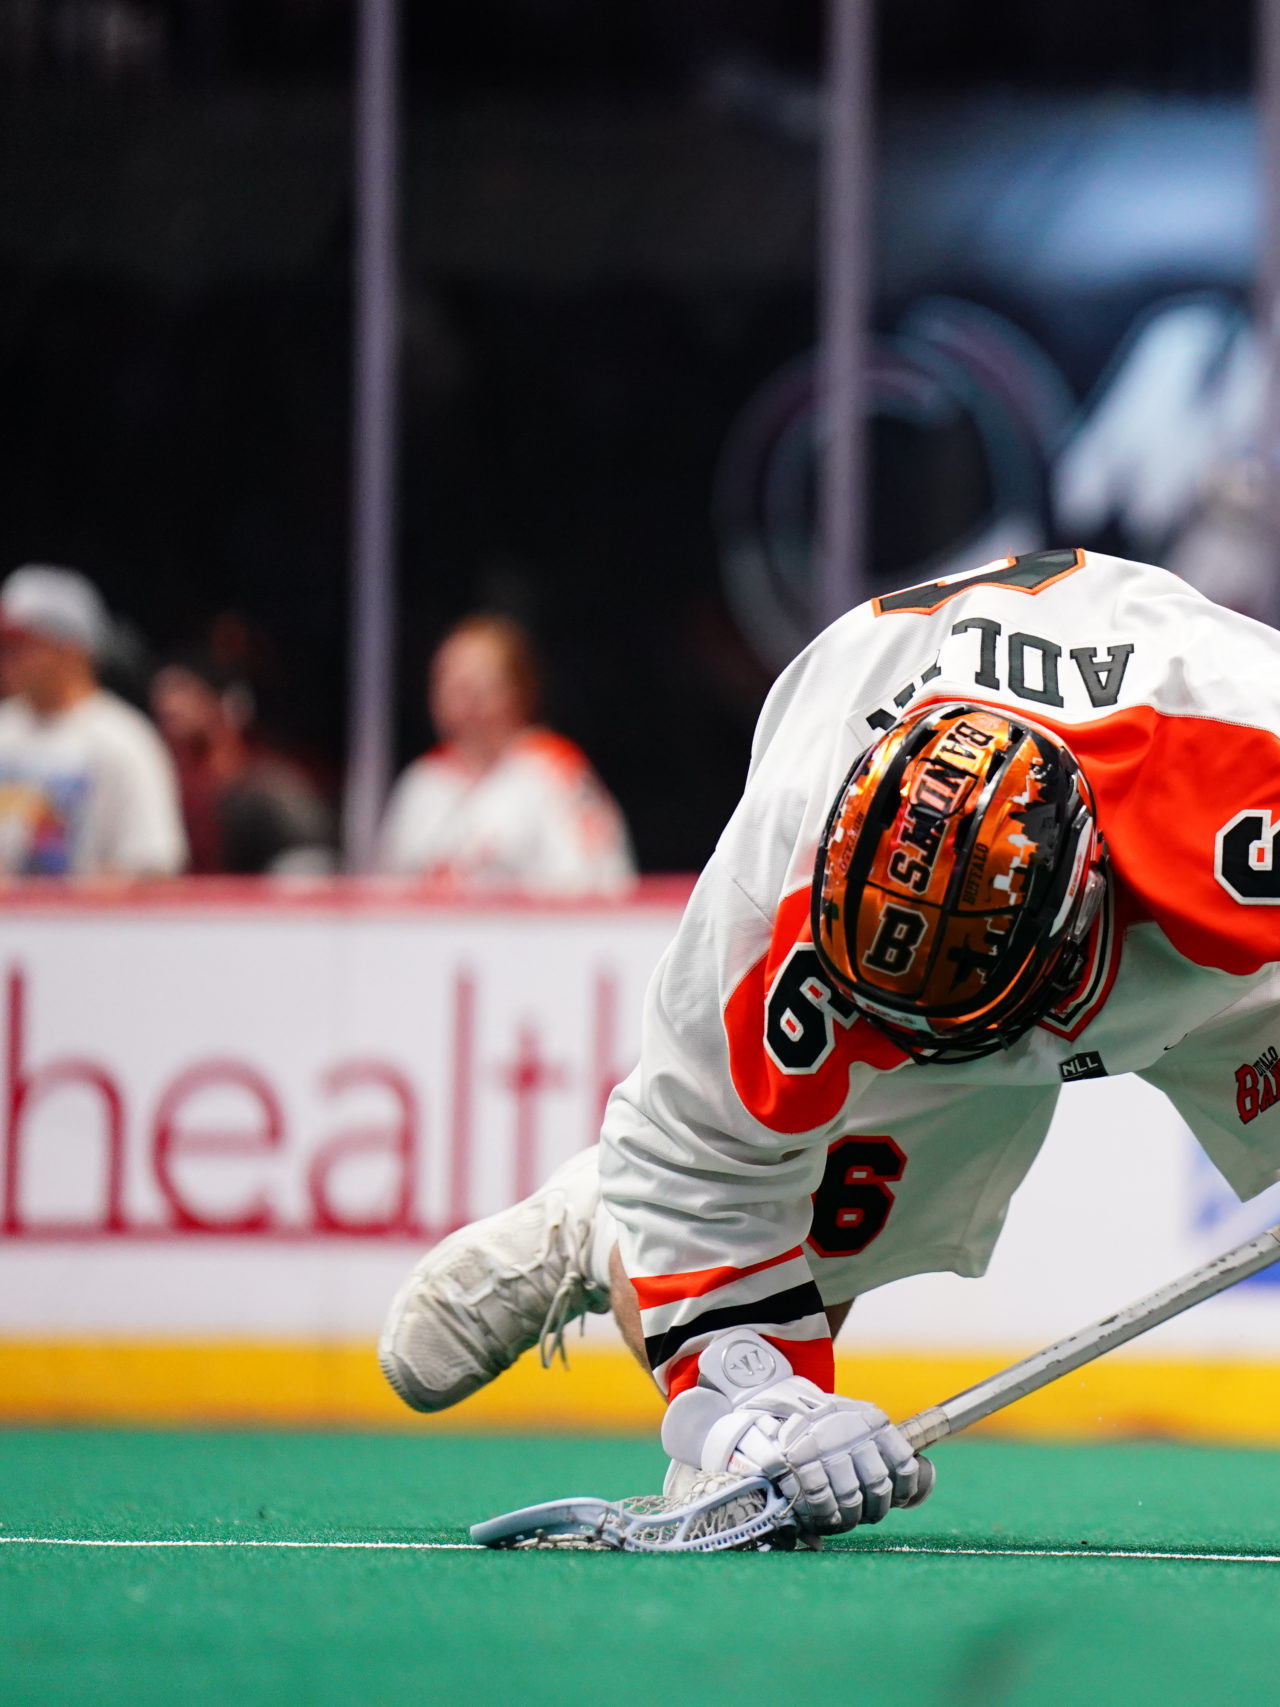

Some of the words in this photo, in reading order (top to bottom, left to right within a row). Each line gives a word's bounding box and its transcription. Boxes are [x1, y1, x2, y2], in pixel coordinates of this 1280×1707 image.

[866, 617, 1133, 731] ADL
[865, 905, 928, 976] B
[764, 941, 860, 1075] 6
[1062, 1056, 1099, 1076] NLL
[806, 1135, 908, 1257] 6
